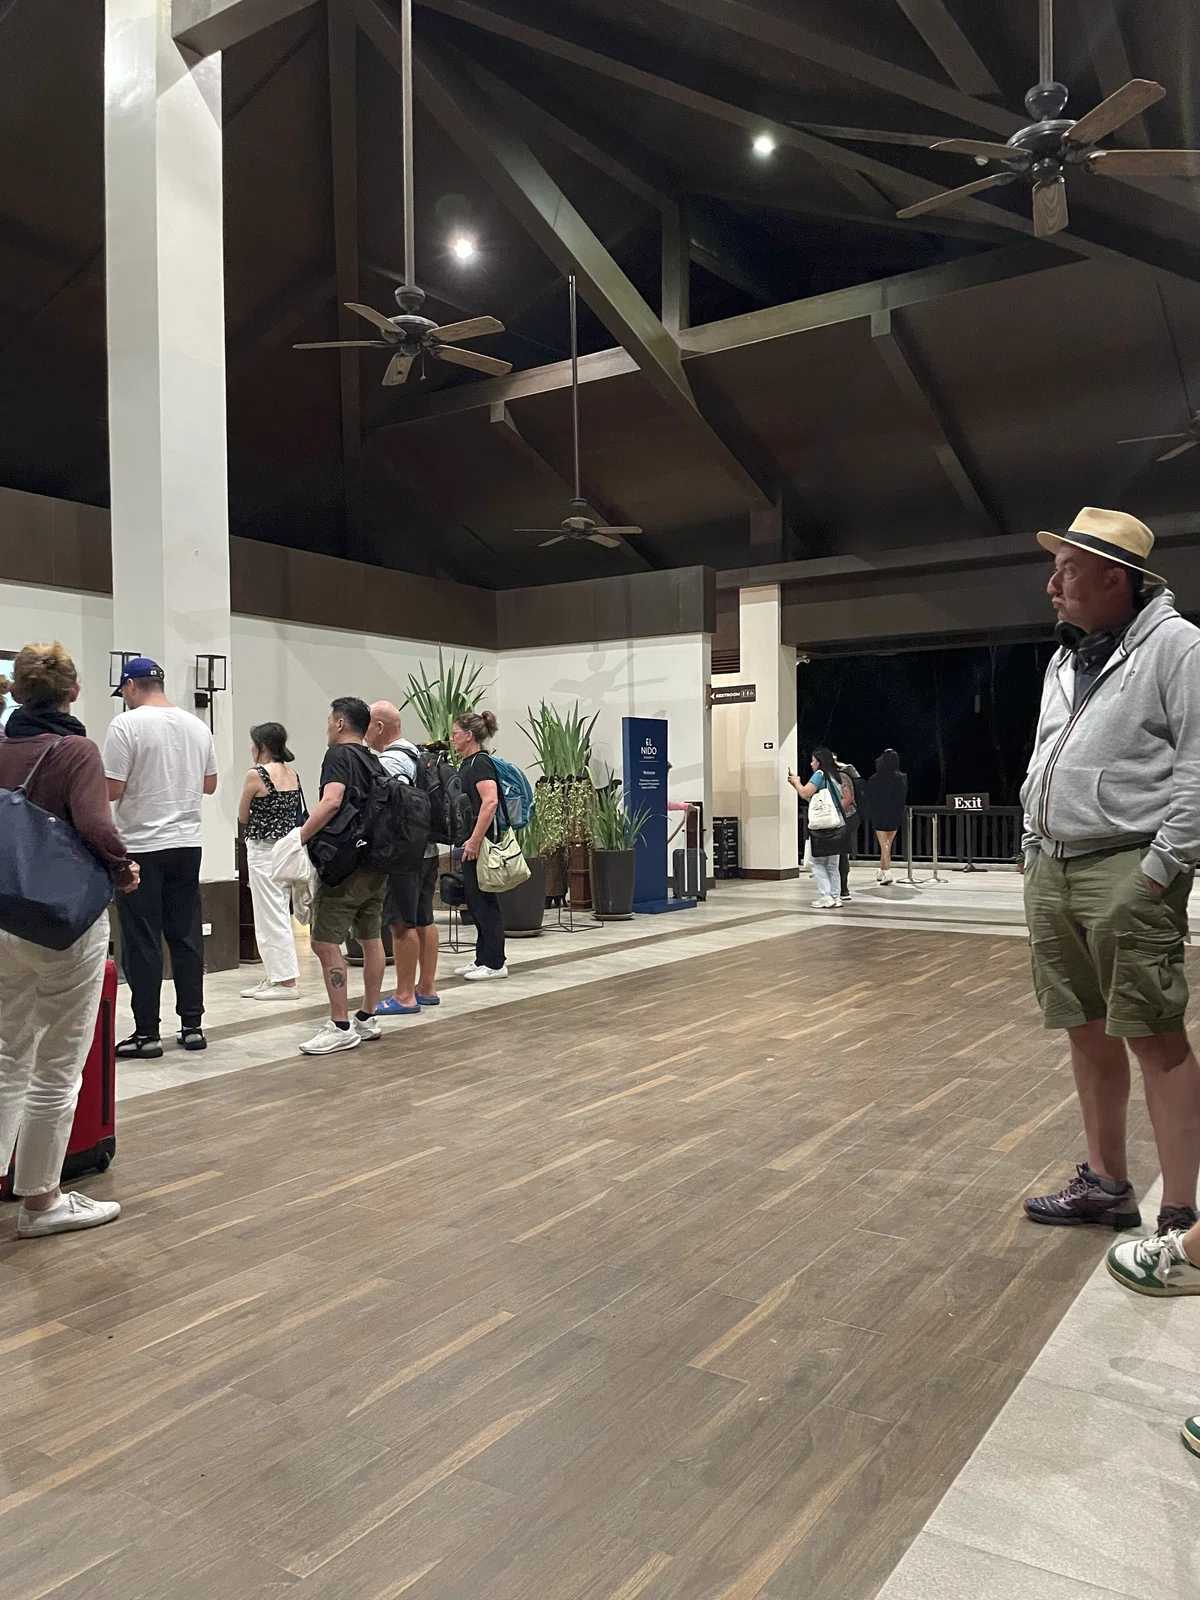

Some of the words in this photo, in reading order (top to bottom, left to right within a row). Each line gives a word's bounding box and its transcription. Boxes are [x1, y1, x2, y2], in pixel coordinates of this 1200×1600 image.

[645, 737, 652, 746] EL
[641, 746, 657, 755] NIDO
[954, 796, 982, 809] Exit
